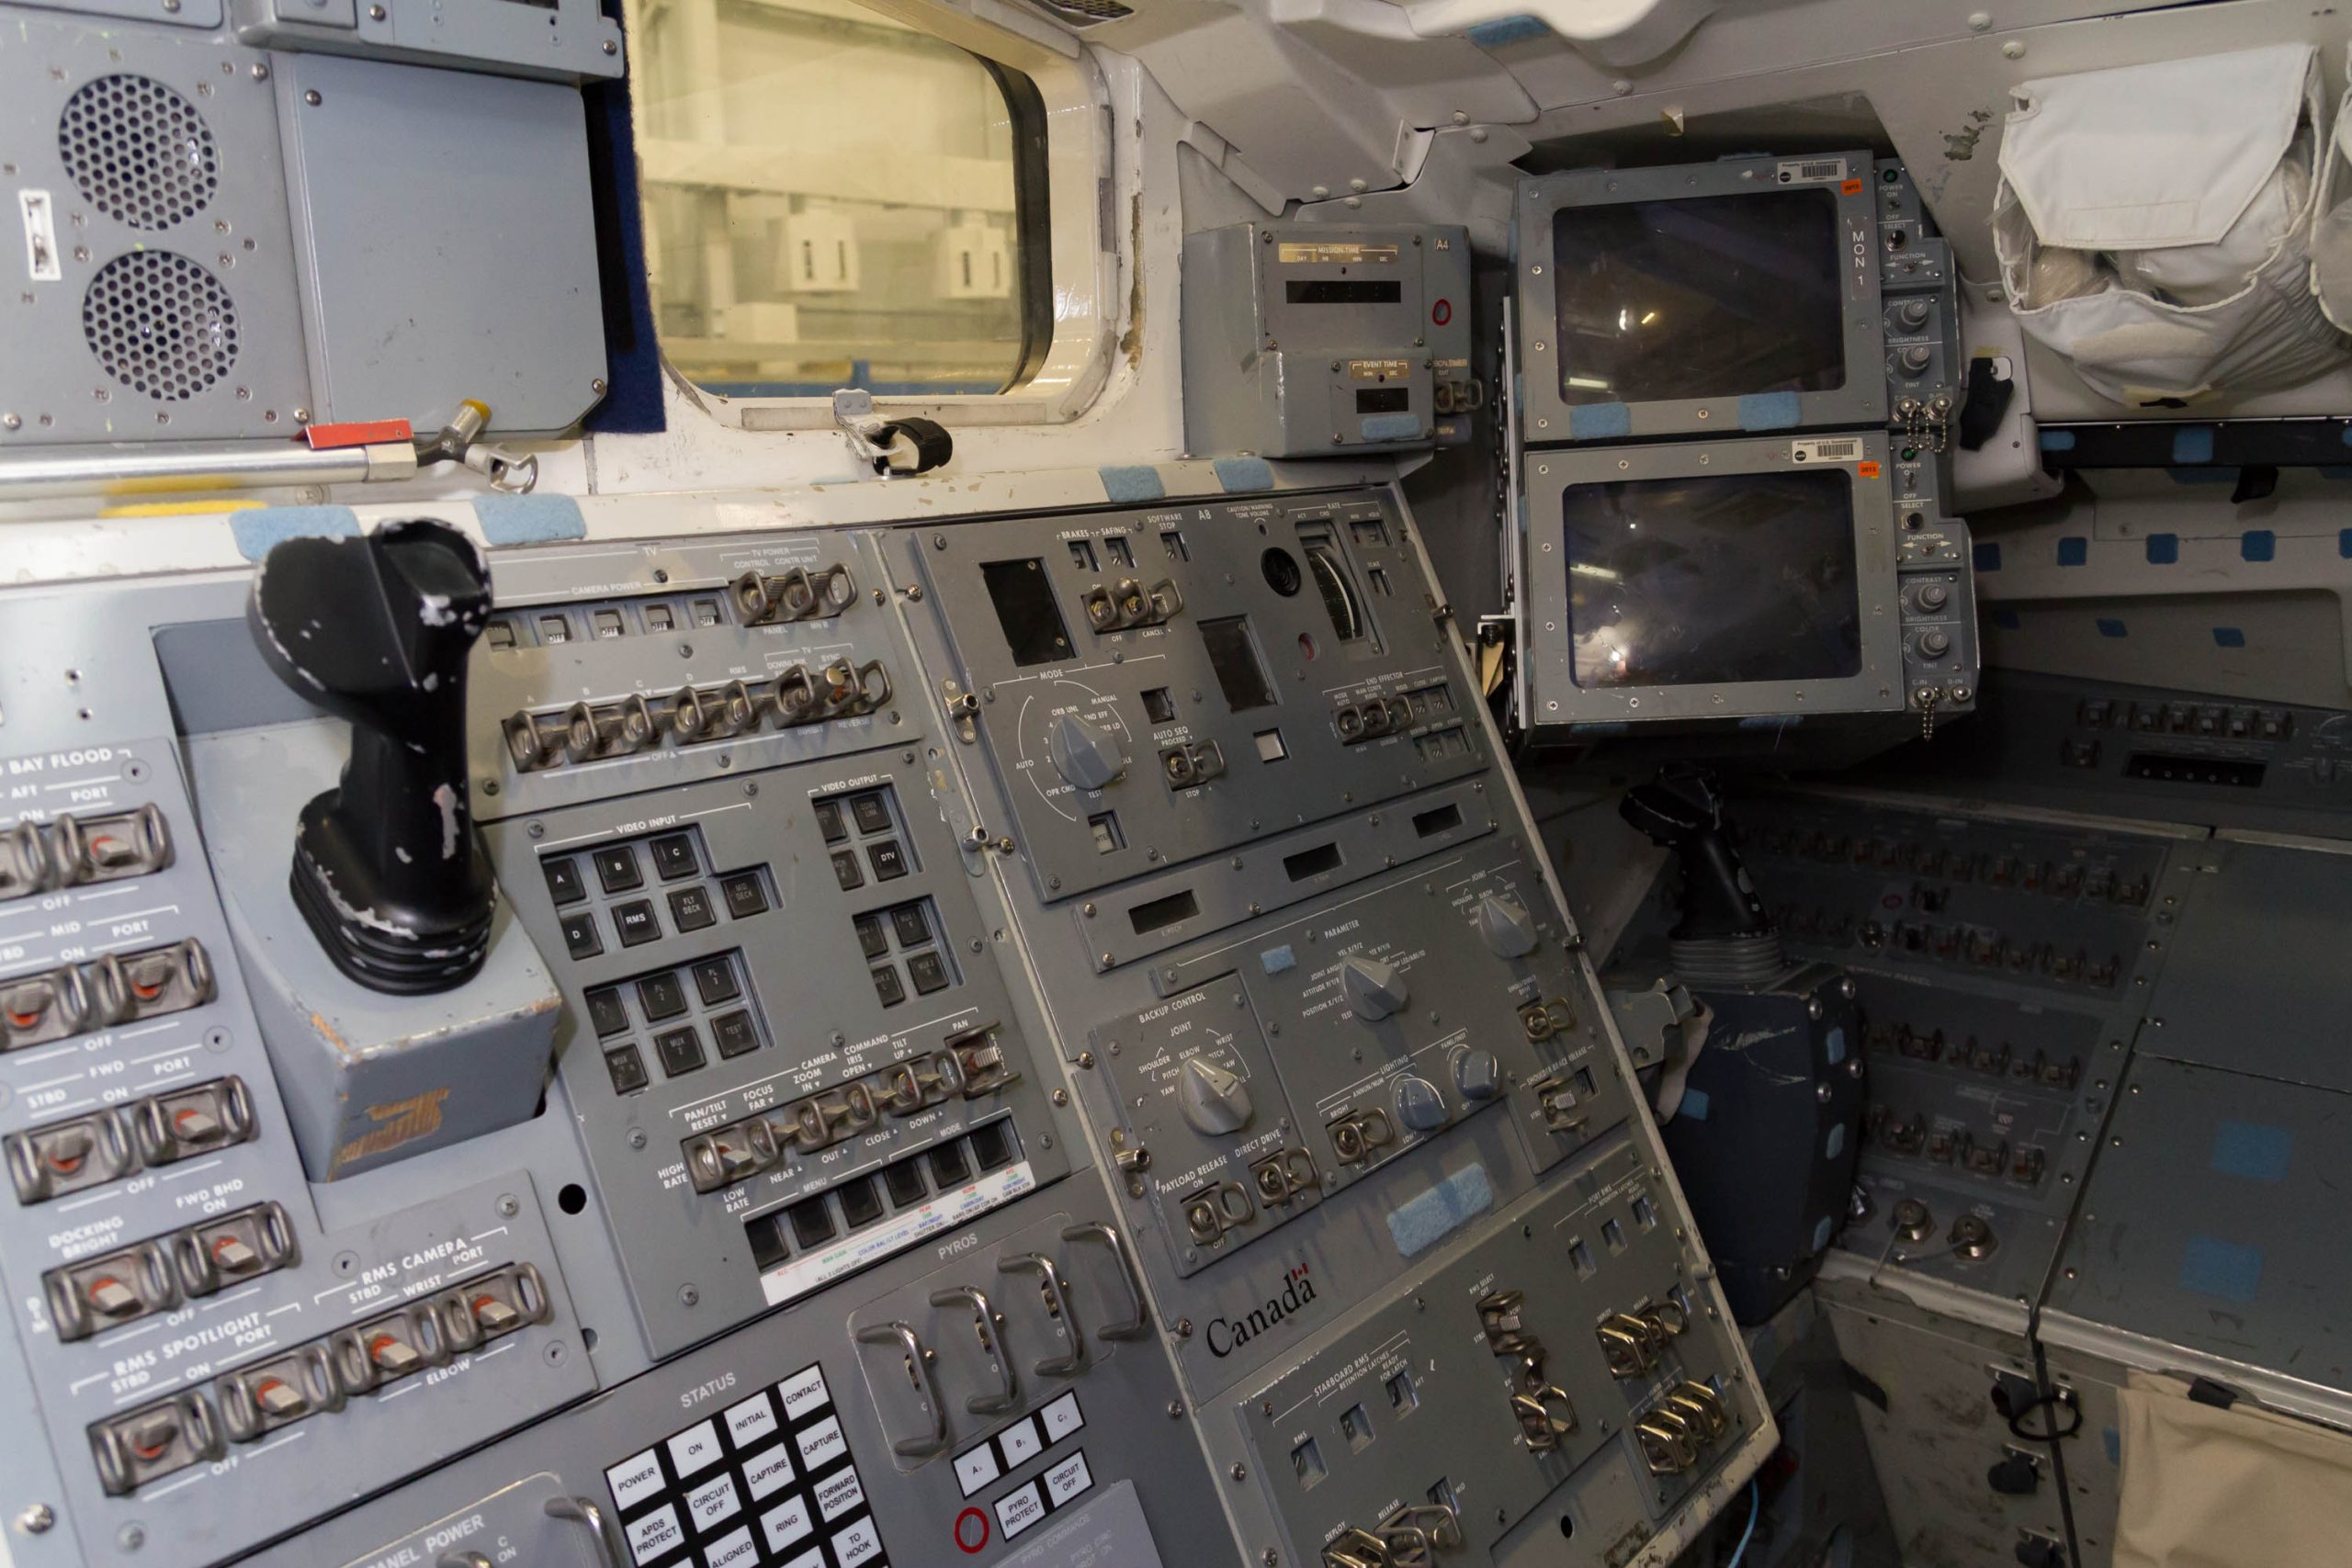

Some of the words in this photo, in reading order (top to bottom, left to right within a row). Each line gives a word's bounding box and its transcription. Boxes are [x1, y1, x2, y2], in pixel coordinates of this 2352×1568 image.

[1436, 240, 1448, 250] A4
[1890, 253, 1926, 261] FUNCTION
[1363, 360, 1382, 368] EVENT
[1148, 513, 1182, 524] SOFTWARE
[1198, 510, 1211, 520] A8
[1101, 525, 1126, 536] SAFING
[1159, 522, 1176, 530] STOP
[1060, 530, 1090, 540] BRAKES
[1906, 533, 1944, 542] FUNCTION
[734, 559, 771, 570] CONTROL
[571, 583, 609, 595] CAMERA
[610, 581, 641, 592] POWER
[1905, 576, 1942, 584] CONTRAST
[1112, 634, 1123, 642] OFF
[1142, 629, 1164, 638] CANCEL
[1039, 670, 1064, 681] MODE
[1378, 671, 1403, 682] EFFECTOR
[1091, 694, 1117, 705] MANUAL
[1153, 728, 1173, 740] AUTO
[1173, 726, 1189, 736] SEQ
[1161, 736, 1187, 746] PROCEED
[9, 756, 43, 774] BAY
[51, 748, 112, 769] FLOOD
[1016, 759, 1035, 770] AUTO
[820, 781, 846, 793] VIDEO
[848, 773, 877, 787] OUTPUT
[1046, 786, 1059, 796] OPR
[1060, 784, 1076, 794] CMD
[11, 784, 38, 799] AFT
[71, 786, 108, 802] PORT
[1088, 790, 1102, 798] TEST
[1185, 789, 1200, 798] STOP
[616, 820, 646, 834] VIDEO
[649, 815, 677, 828] INPUT
[673, 848, 681, 856] C
[880, 852, 896, 863] DTV
[615, 862, 622, 871] B
[557, 874, 565, 884] A
[42, 895, 71, 910] OFF
[626, 913, 646, 925] RMS
[51, 920, 81, 936] MID
[112, 920, 149, 937] PORT
[572, 930, 581, 940] D
[1324, 919, 1360, 939] PARAMETER
[61, 946, 85, 962] ON
[1138, 1005, 1169, 1023] BACKUP
[1171, 991, 1206, 1010] CONTROL
[1341, 1010, 1352, 1021] TEST
[952, 1020, 969, 1032] PAN
[1170, 1021, 1193, 1037] JOINT
[85, 1035, 113, 1051] OFF
[892, 1037, 908, 1051] TILT
[1216, 1033, 1234, 1046] WRIST
[801, 1052, 838, 1071] CAMERA
[843, 1034, 889, 1055] COMMAND
[846, 1053, 863, 1066] IRIS
[893, 1047, 905, 1060] UP
[1179, 1045, 1201, 1060] ELBOW
[89, 1061, 125, 1077] FWD
[153, 1056, 191, 1076] PORT
[842, 1063, 865, 1078] OPEN
[1138, 1055, 1170, 1075] SHOULDER
[1379, 1055, 1408, 1075] LIGHTING
[793, 1067, 822, 1085] ZOOM
[1162, 1067, 1180, 1081] PITCH
[27, 1089, 67, 1107] STBD
[103, 1087, 129, 1102] ON
[742, 1084, 774, 1102] FOCUS
[1160, 1085, 1175, 1096] YAW
[684, 1100, 727, 1122] PAN/TILT
[749, 1098, 766, 1111] FAR
[1330, 1105, 1349, 1119] BRIGHT
[691, 1115, 718, 1133] RESET
[909, 1112, 936, 1130] DOWN
[940, 1122, 962, 1138] MODE
[865, 1131, 891, 1147] CLOSE
[1234, 1140, 1259, 1158] DIRECT
[1260, 1128, 1282, 1146] DRIVE
[820, 1151, 840, 1164] OUT
[657, 1162, 685, 1179] HIGH
[769, 1168, 796, 1185] NEAR
[1160, 1171, 1196, 1194] PAYLOAD
[1197, 1155, 1228, 1177] RELEASE
[127, 1177, 155, 1194] OFF
[663, 1174, 688, 1190] RATE
[803, 1177, 827, 1193] MENU
[1193, 1179, 1204, 1189] ON
[175, 1190, 209, 1209] FWD
[212, 1179, 244, 1197] BHD
[722, 1187, 746, 1203] LOW
[203, 1198, 228, 1214] ON
[726, 1197, 751, 1213] RATE
[48, 1215, 124, 1248] DOCKING
[62, 1234, 119, 1259] BRIGHT
[937, 1233, 978, 1260] PYROS
[1213, 1239, 1226, 1249] OFF
[361, 1263, 397, 1285] RMS
[401, 1238, 469, 1269] CAMERA
[452, 1246, 484, 1265] PORT
[403, 1274, 443, 1297] WRIST
[348, 1284, 382, 1305] STBD
[166, 1308, 196, 1326] OFF
[1206, 1273, 1317, 1359] Canada
[113, 1351, 157, 1377] RMS
[162, 1312, 261, 1360] SPOTLIGHT
[234, 1325, 273, 1348] PORT
[1380, 1370, 1393, 1382] FOR
[1393, 1359, 1408, 1375] LATCH
[1382, 1354, 1399, 1371] READY
[186, 1362, 211, 1380] ON
[425, 1359, 471, 1386] ELBOW
[1314, 1364, 1354, 1397] STARBOARD
[1353, 1352, 1370, 1370] RMS
[1339, 1369, 1367, 1391] RETENTION
[1367, 1351, 1389, 1372] LATCHES
[110, 1371, 151, 1394] STBD
[680, 1372, 737, 1408] STATUS
[1414, 1376, 1424, 1388] AFT
[786, 1380, 822, 1405] CONTACT
[735, 1410, 767, 1431] INITIAL
[803, 1429, 840, 1456] CAPTURE
[1294, 1430, 1308, 1445] RMS
[688, 1442, 703, 1456] ON
[210, 1455, 239, 1475] OFF
[751, 1459, 787, 1485] CAPTURE
[618, 1466, 656, 1493] POWER
[1052, 1463, 1080, 1486] CIRCUIT
[819, 1474, 856, 1502] FORWARD
[1062, 1477, 1077, 1492] OFF
[1454, 1482, 1466, 1495] MID
[693, 1483, 730, 1509] CIRCUIT
[824, 1486, 858, 1512] POSITION
[1008, 1495, 1029, 1513] PYRO
[707, 1500, 726, 1517] OFF
[1005, 1502, 1039, 1529] PROTECT
[1378, 1499, 1400, 1520] RELEASE
[641, 1518, 665, 1539] APDS
[775, 1514, 798, 1533] RING
[1325, 1520, 1346, 1542] DEPLOY
[424, 1514, 485, 1553] POWER
[636, 1526, 677, 1555] PROTECT
[848, 1532, 861, 1545] TO
[497, 1546, 517, 1562] ON
[712, 1540, 753, 1568] ALIGNED
[846, 1539, 872, 1561] HOOK
